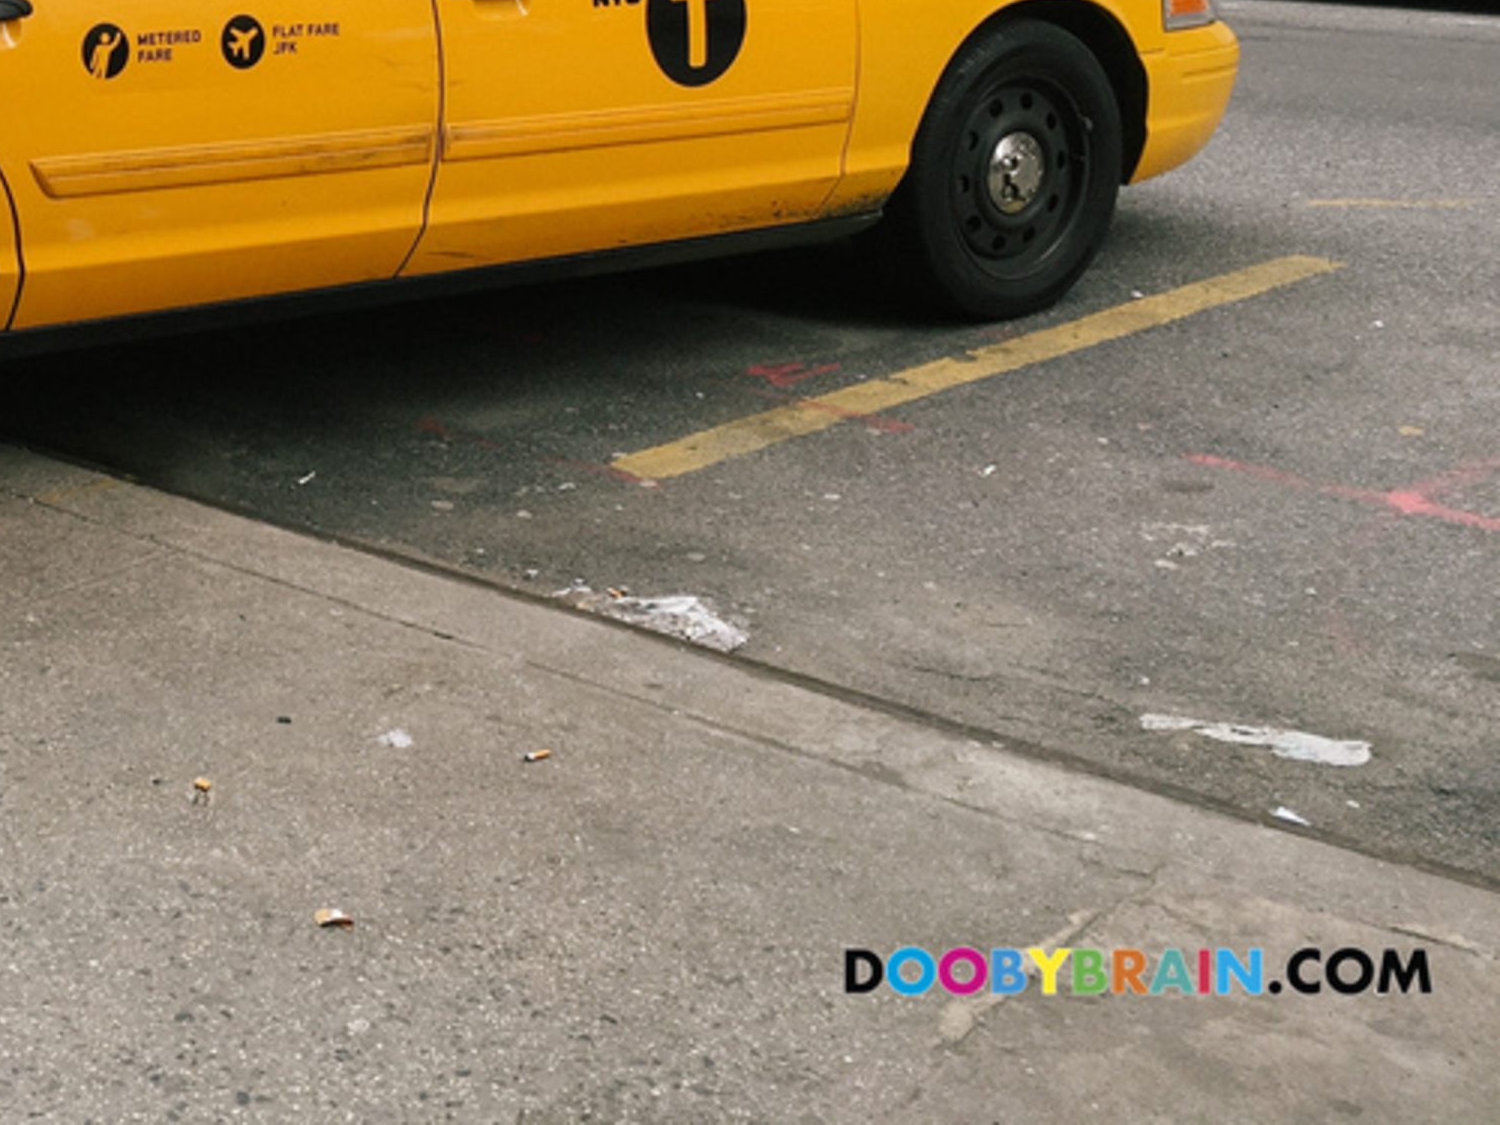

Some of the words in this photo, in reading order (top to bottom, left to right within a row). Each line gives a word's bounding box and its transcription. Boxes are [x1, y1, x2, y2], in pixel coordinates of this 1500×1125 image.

[137, 29, 202, 46] METERED
[272, 25, 304, 38] FLAT
[307, 23, 340, 36] FARE
[137, 48, 172, 63] FARE
[273, 41, 297, 55] JFK
